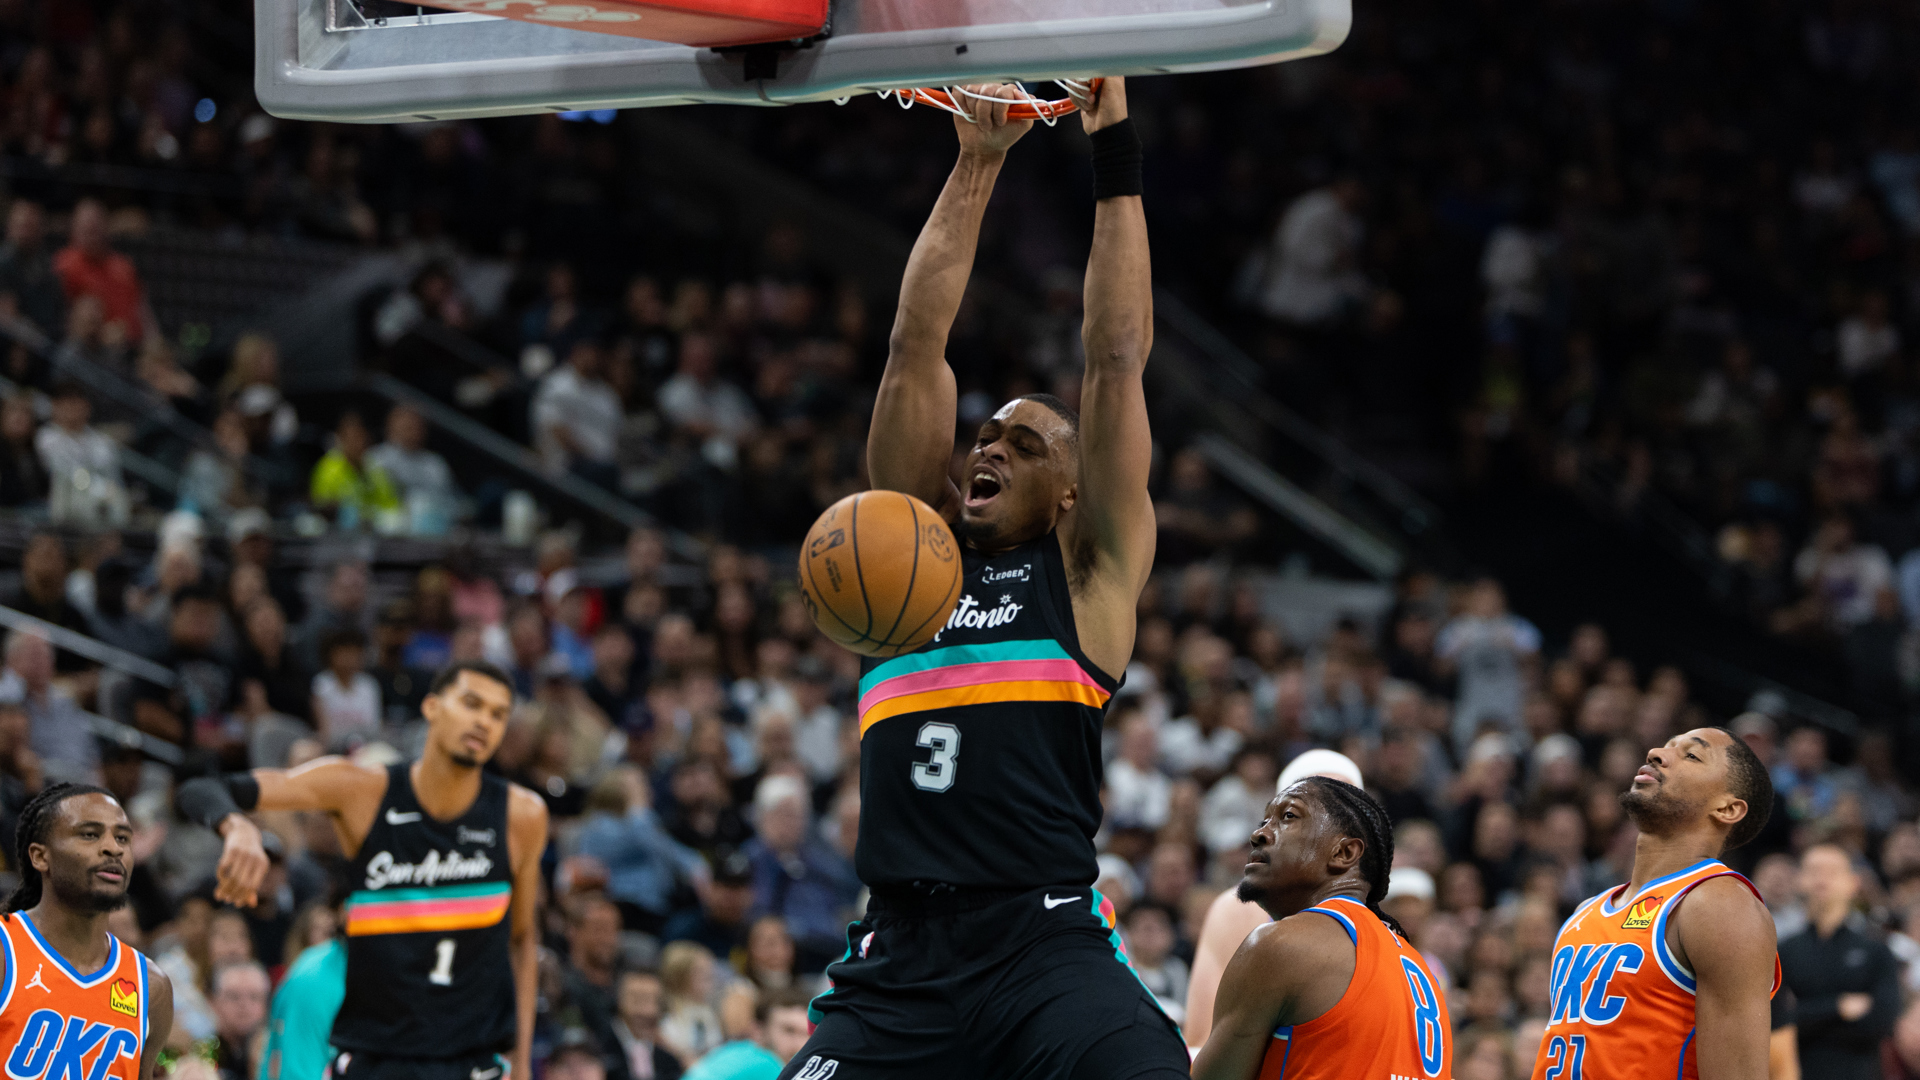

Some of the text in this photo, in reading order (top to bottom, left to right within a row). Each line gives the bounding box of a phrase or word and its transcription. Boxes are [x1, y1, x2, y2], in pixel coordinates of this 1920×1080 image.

[988, 569, 1025, 581] LEDGER
[934, 593, 1024, 642] ntonio
[910, 721, 962, 793] 3
[364, 848, 494, 890] San Antonio
[428, 939, 457, 986] 1
[1545, 943, 1645, 1030] OKC
[5, 1008, 138, 1080] OKC
[1400, 954, 1443, 1078] 8
